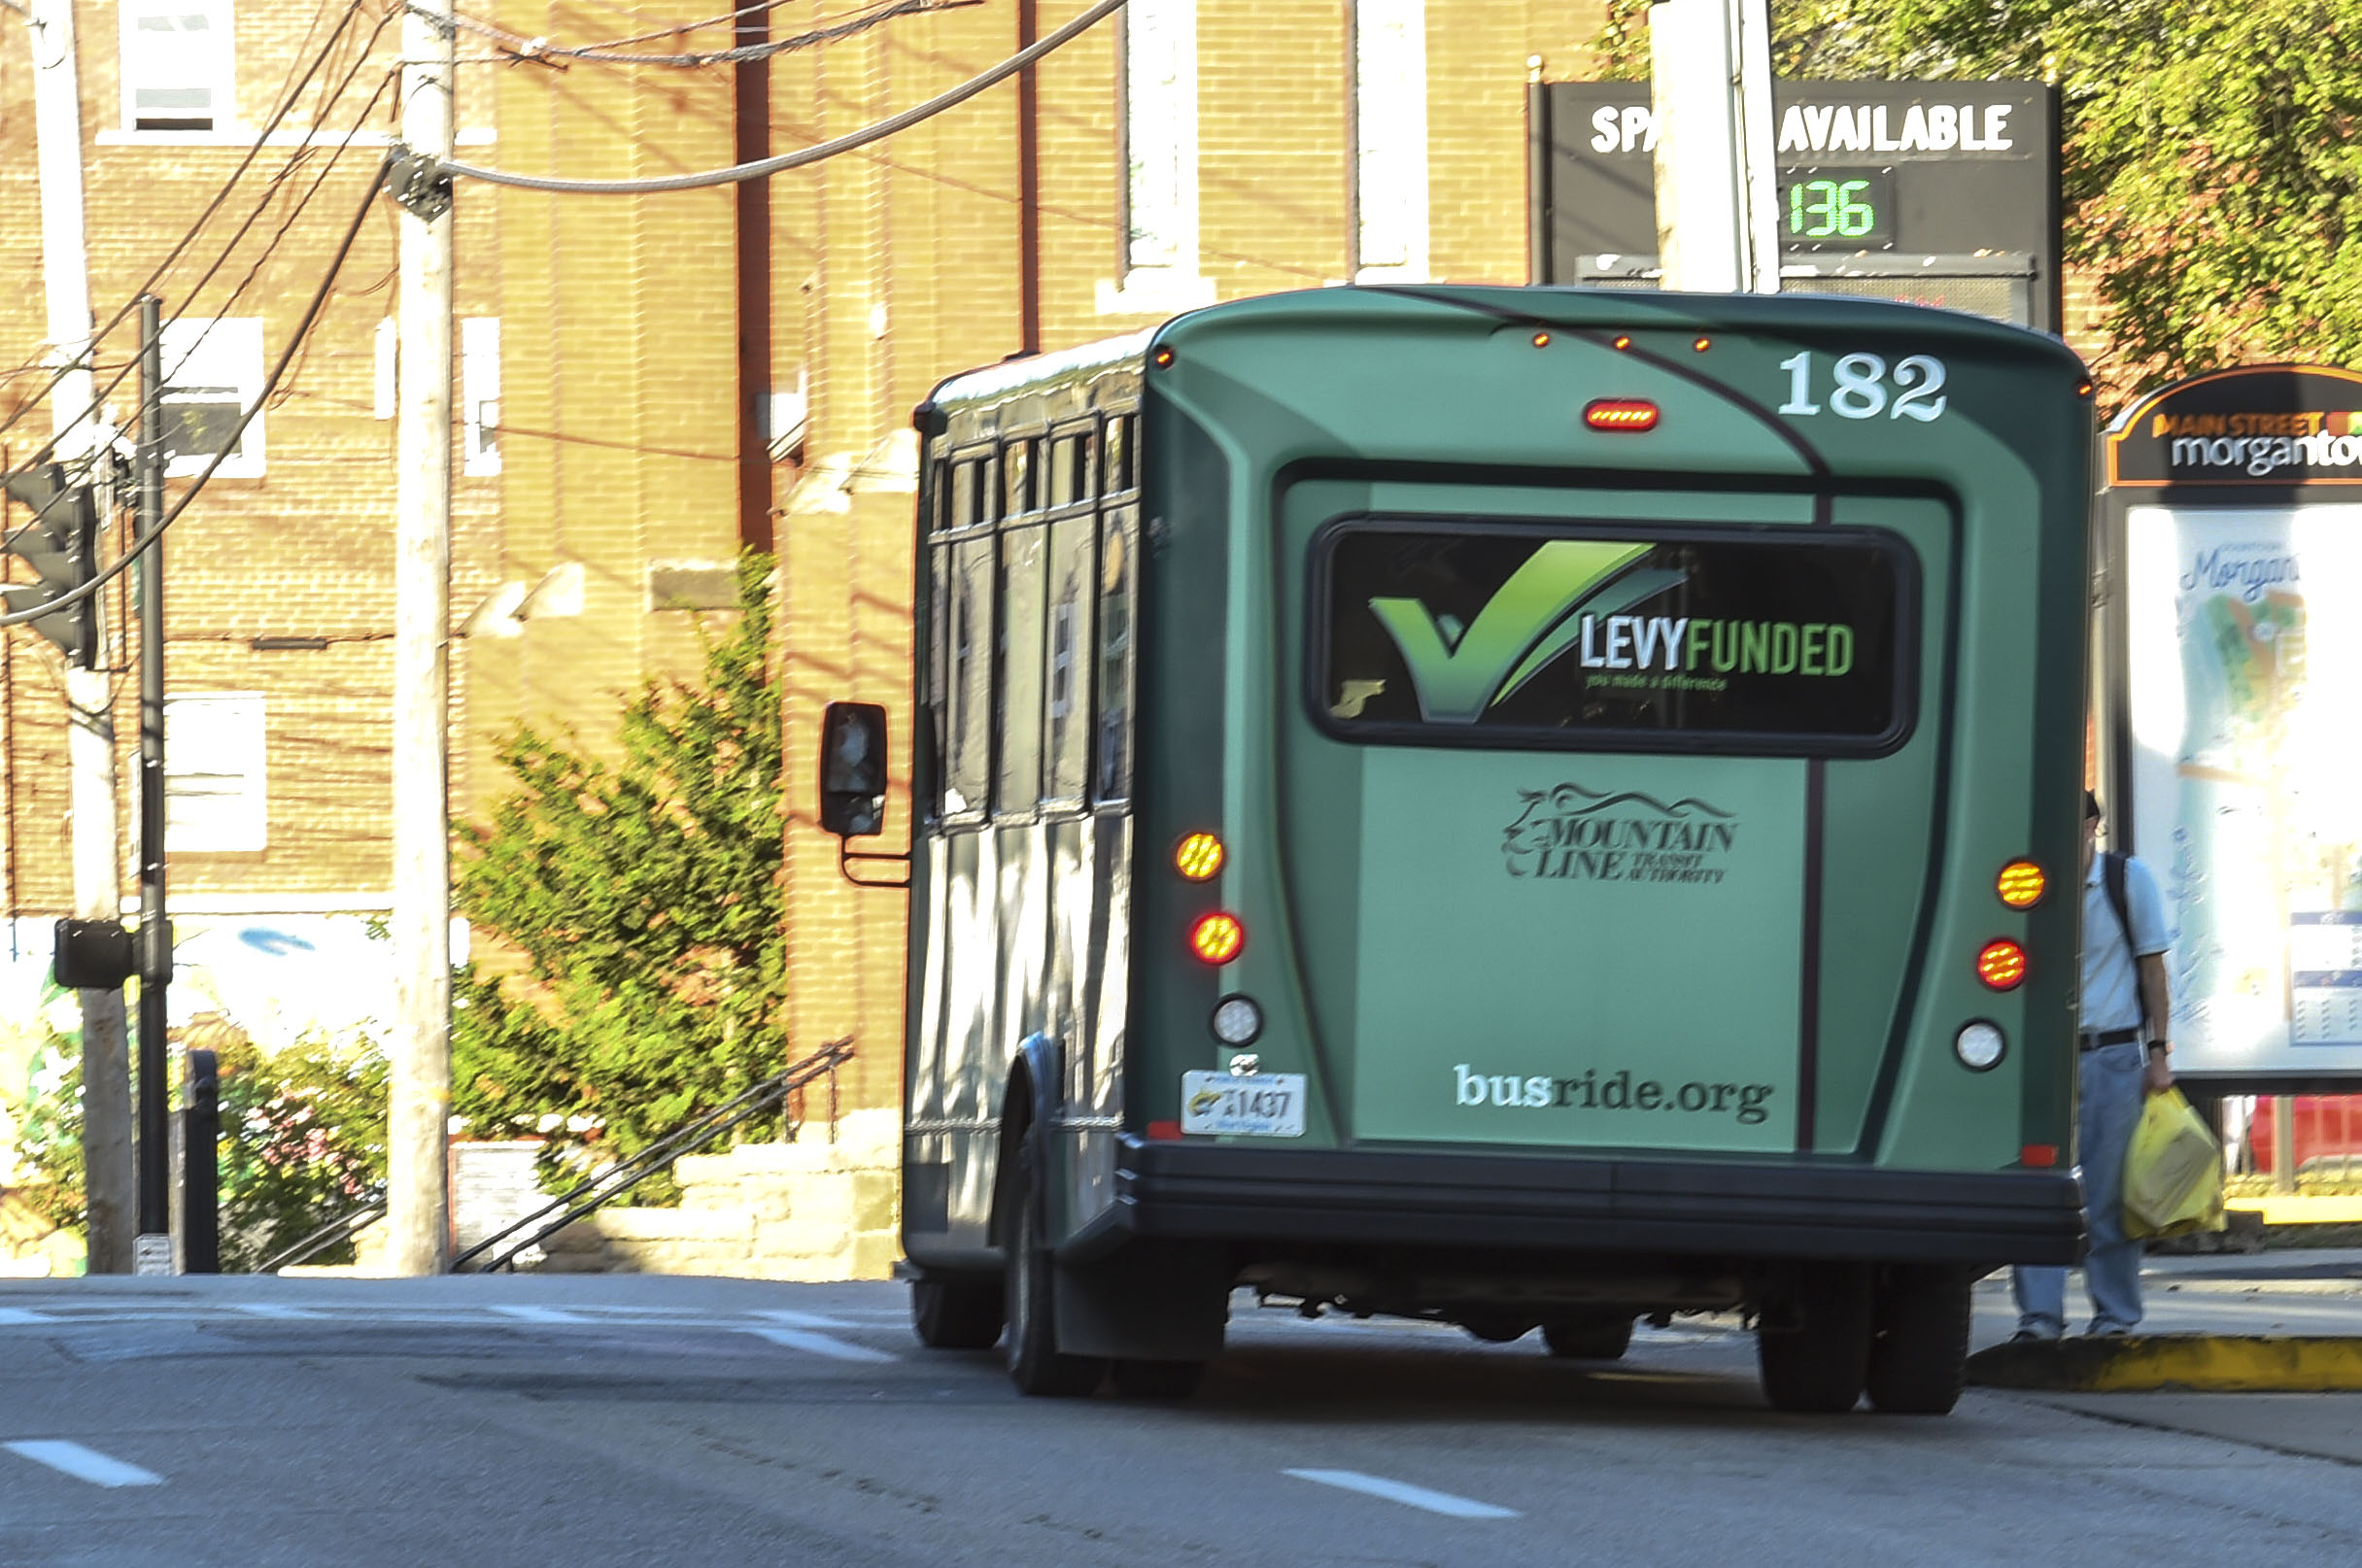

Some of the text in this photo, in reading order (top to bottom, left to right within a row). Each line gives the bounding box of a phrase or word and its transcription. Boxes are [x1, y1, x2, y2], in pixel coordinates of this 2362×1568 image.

[1777, 104, 2013, 152] AVAILABLE
[1789, 180, 1874, 237] 136
[1778, 351, 1947, 422] 182
[2152, 412, 2325, 438] MAIN STREET
[2172, 429, 2362, 476] morganto
[1549, 817, 1737, 851] MOUNTAIN
[1533, 848, 1626, 880] LINE
[1454, 1063, 1774, 1125] busride.org
